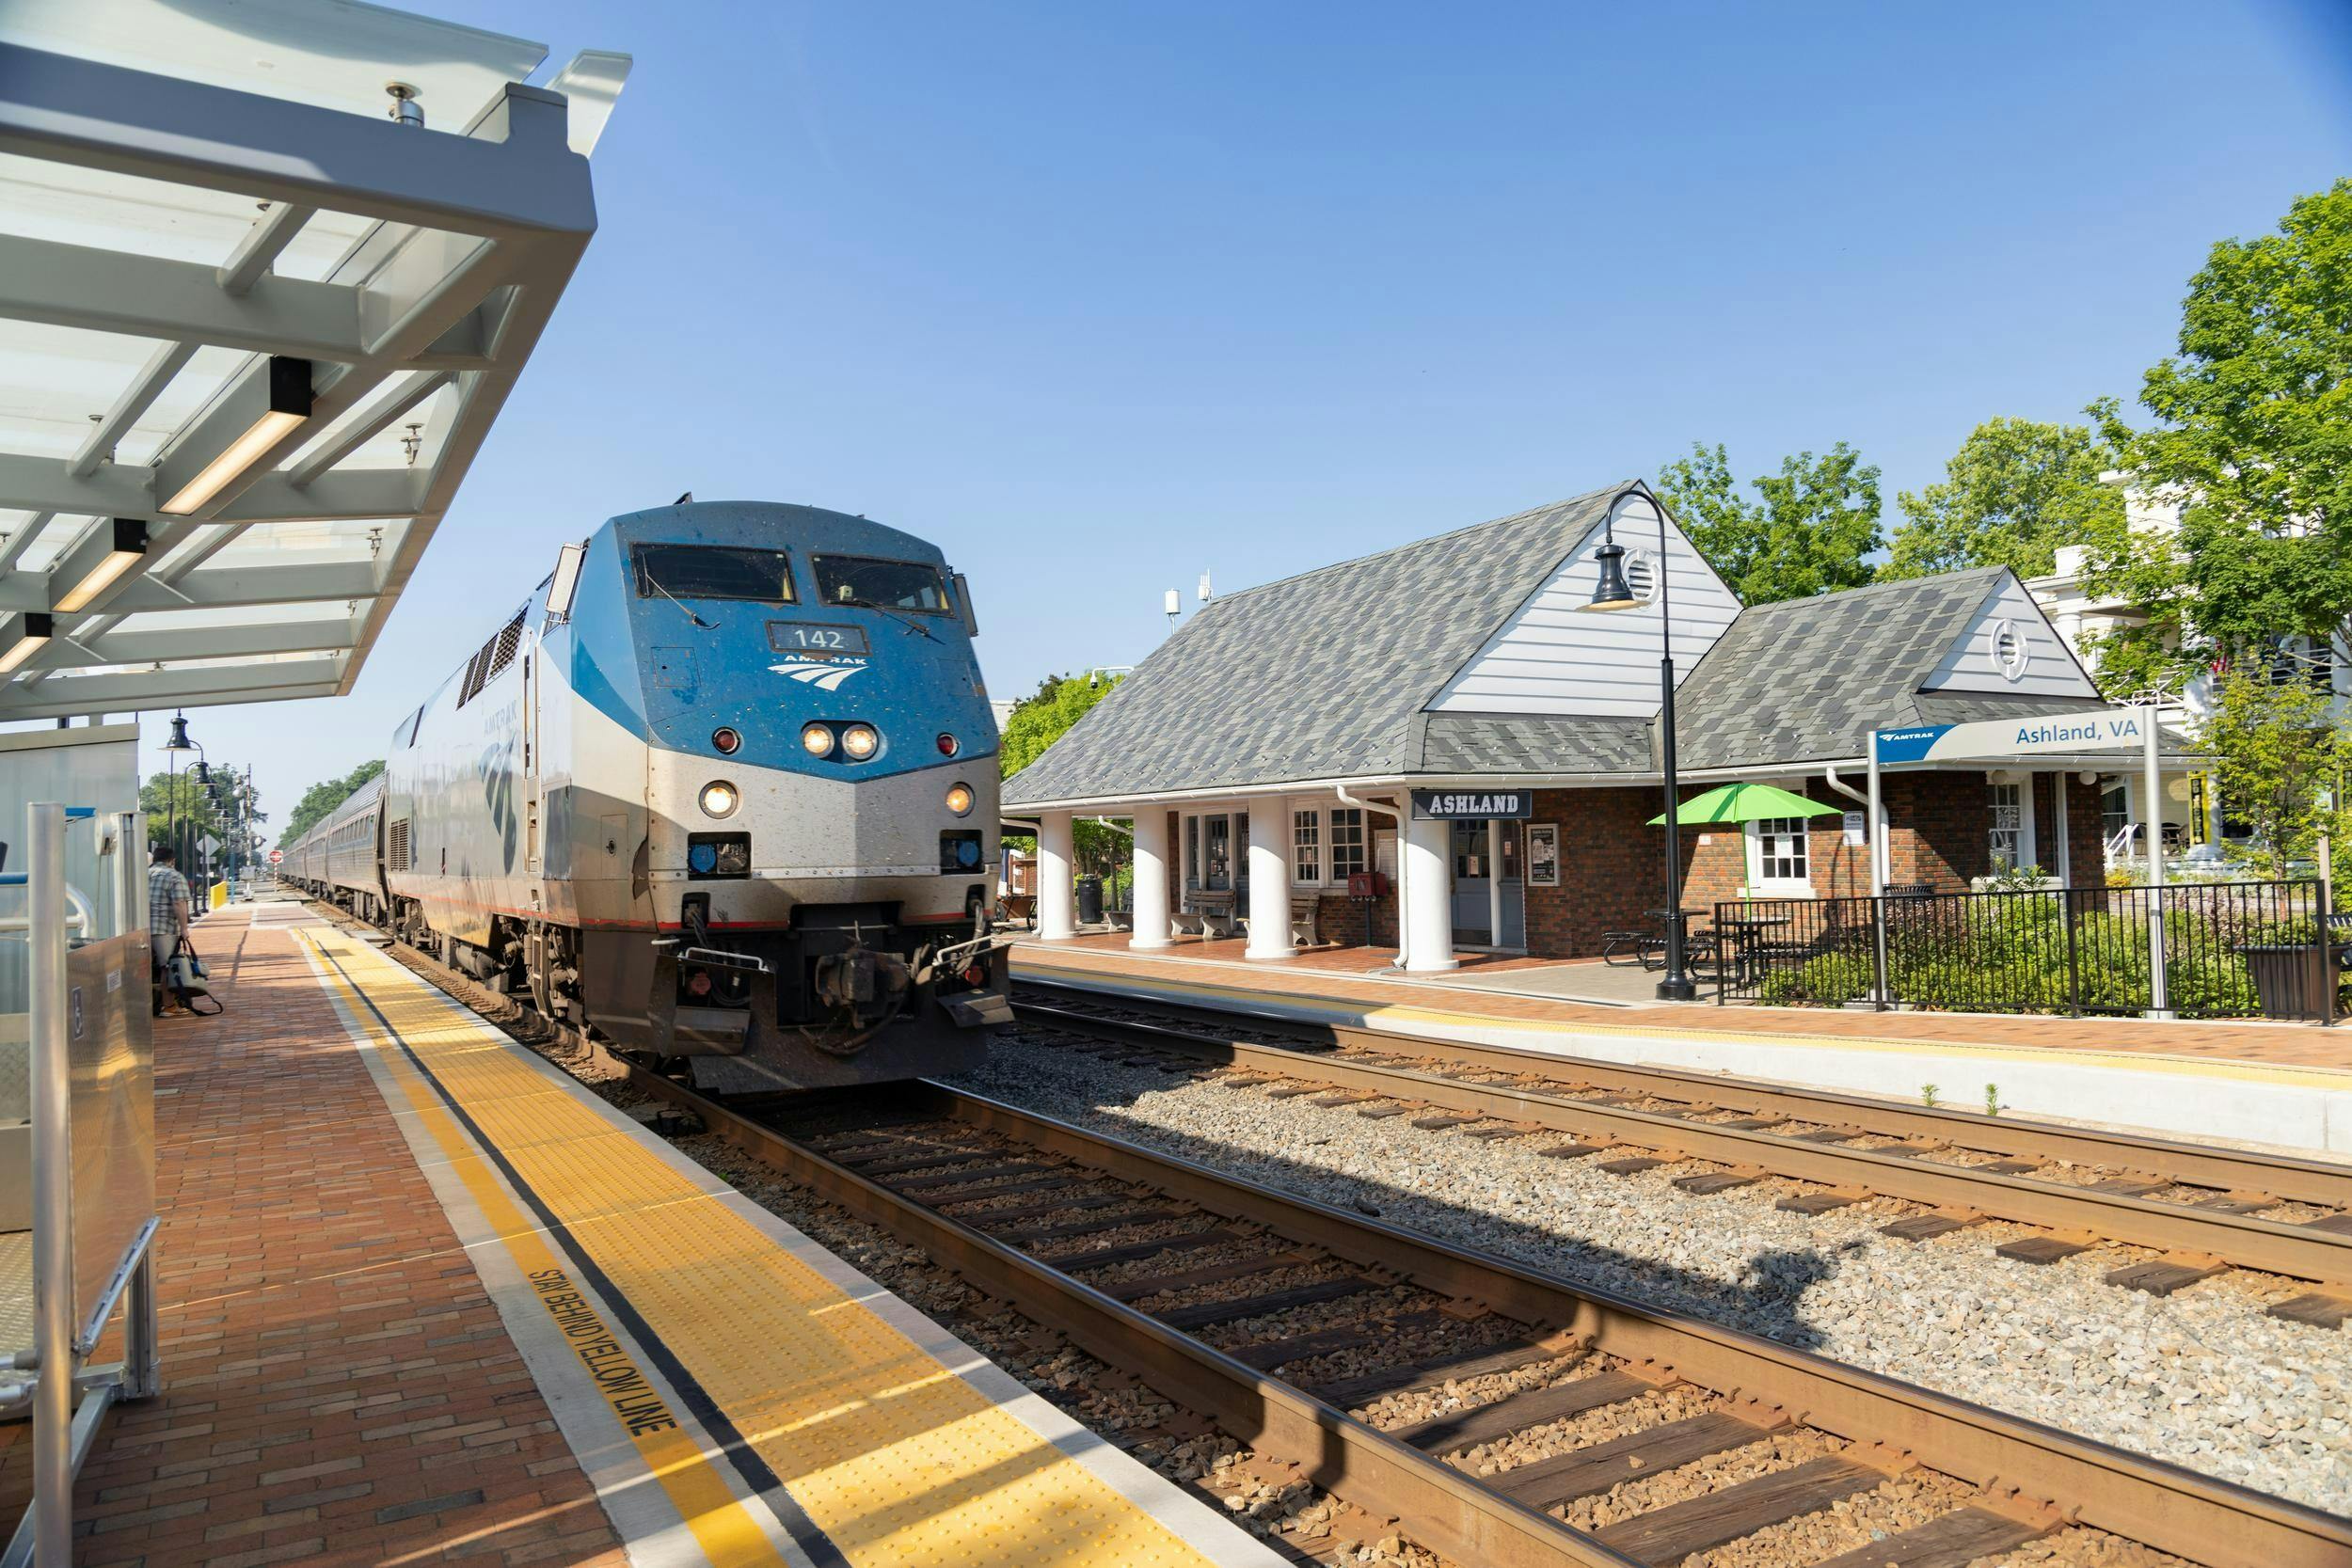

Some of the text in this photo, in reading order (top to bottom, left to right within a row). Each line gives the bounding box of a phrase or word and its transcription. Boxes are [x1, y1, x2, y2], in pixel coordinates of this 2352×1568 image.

[794, 629, 845, 649] 142
[784, 655, 867, 665] AMRAK
[1893, 732, 1934, 741] AMTRAK
[2016, 720, 2138, 744] Ashland, VA
[1429, 795, 1518, 814] ASHLAND
[529, 1269, 677, 1437] STAY BEHIND YELLOW LINE
